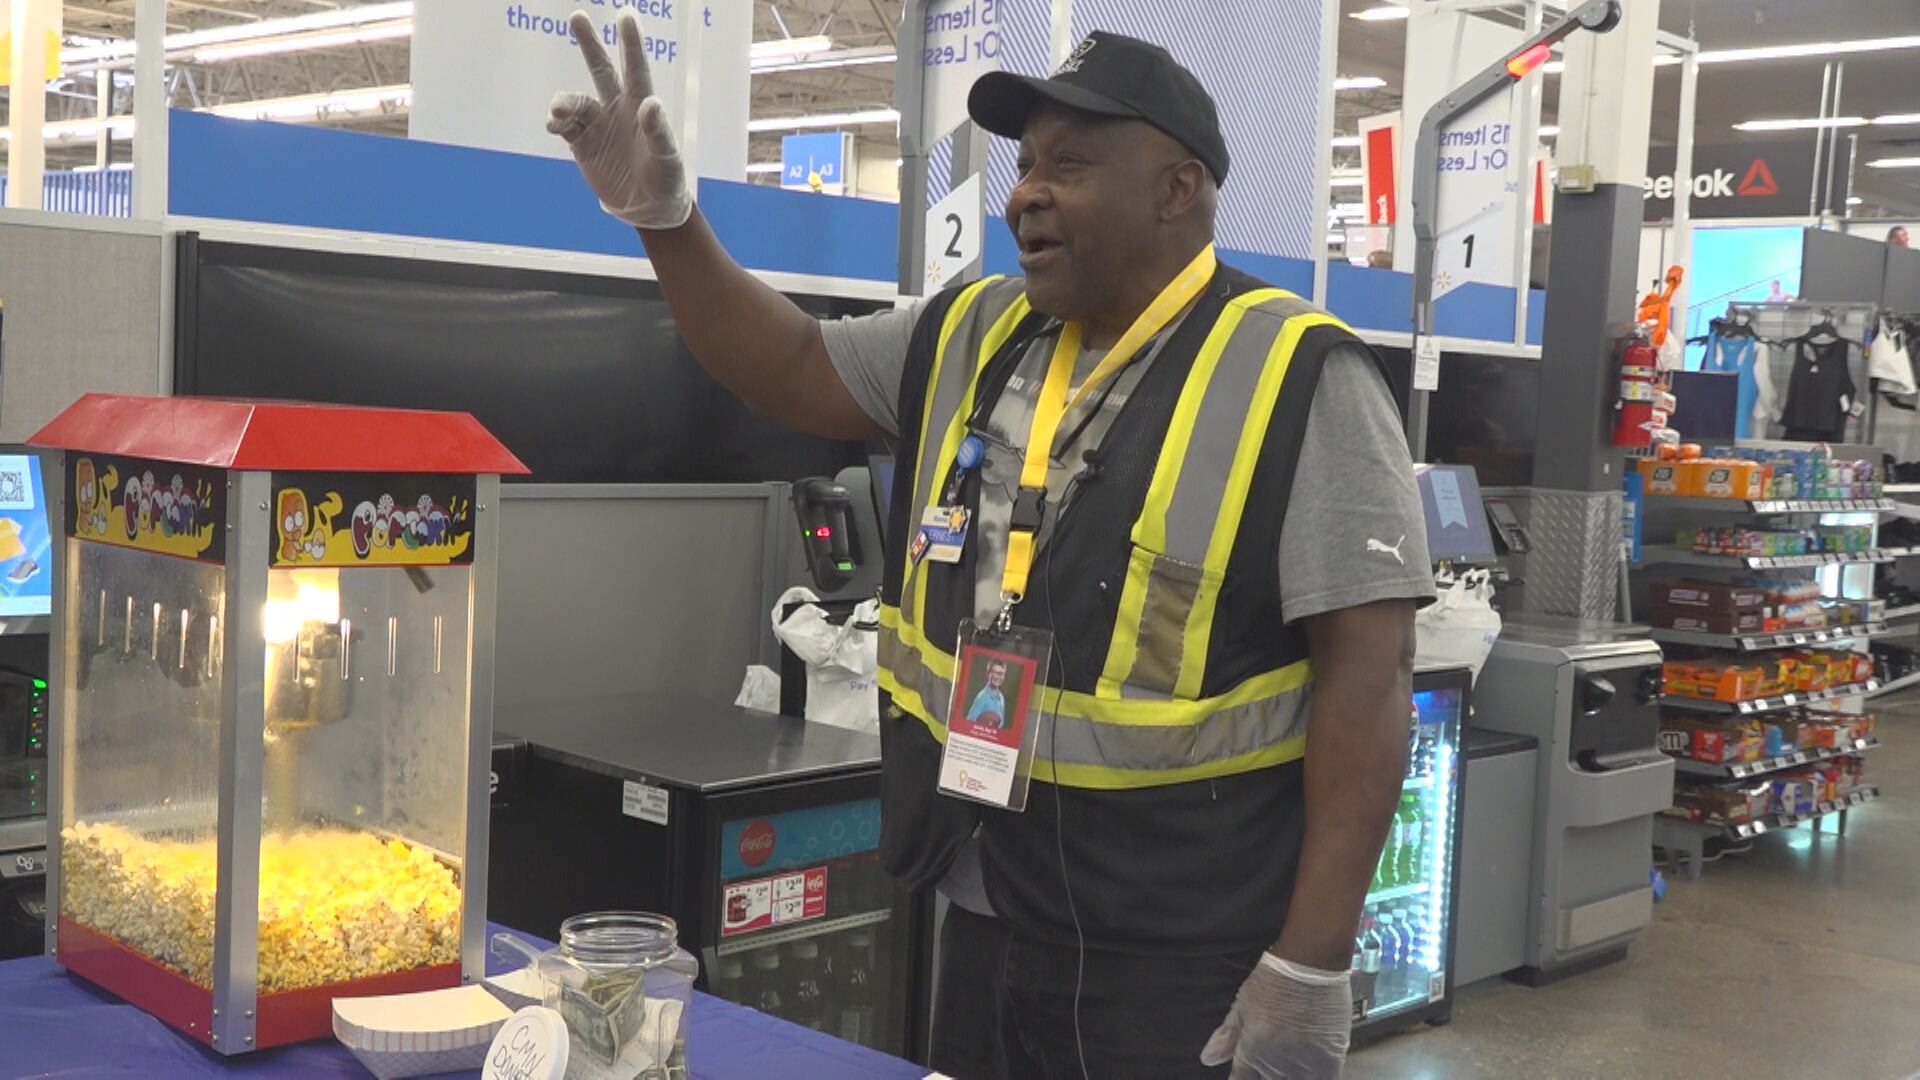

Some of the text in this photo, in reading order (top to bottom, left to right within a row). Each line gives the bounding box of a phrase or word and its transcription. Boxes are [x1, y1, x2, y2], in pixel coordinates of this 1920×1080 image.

[507, 6, 579, 46] throug
[1643, 168, 1735, 198] eeok
[944, 213, 962, 258] 2
[1462, 234, 1475, 268] 1
